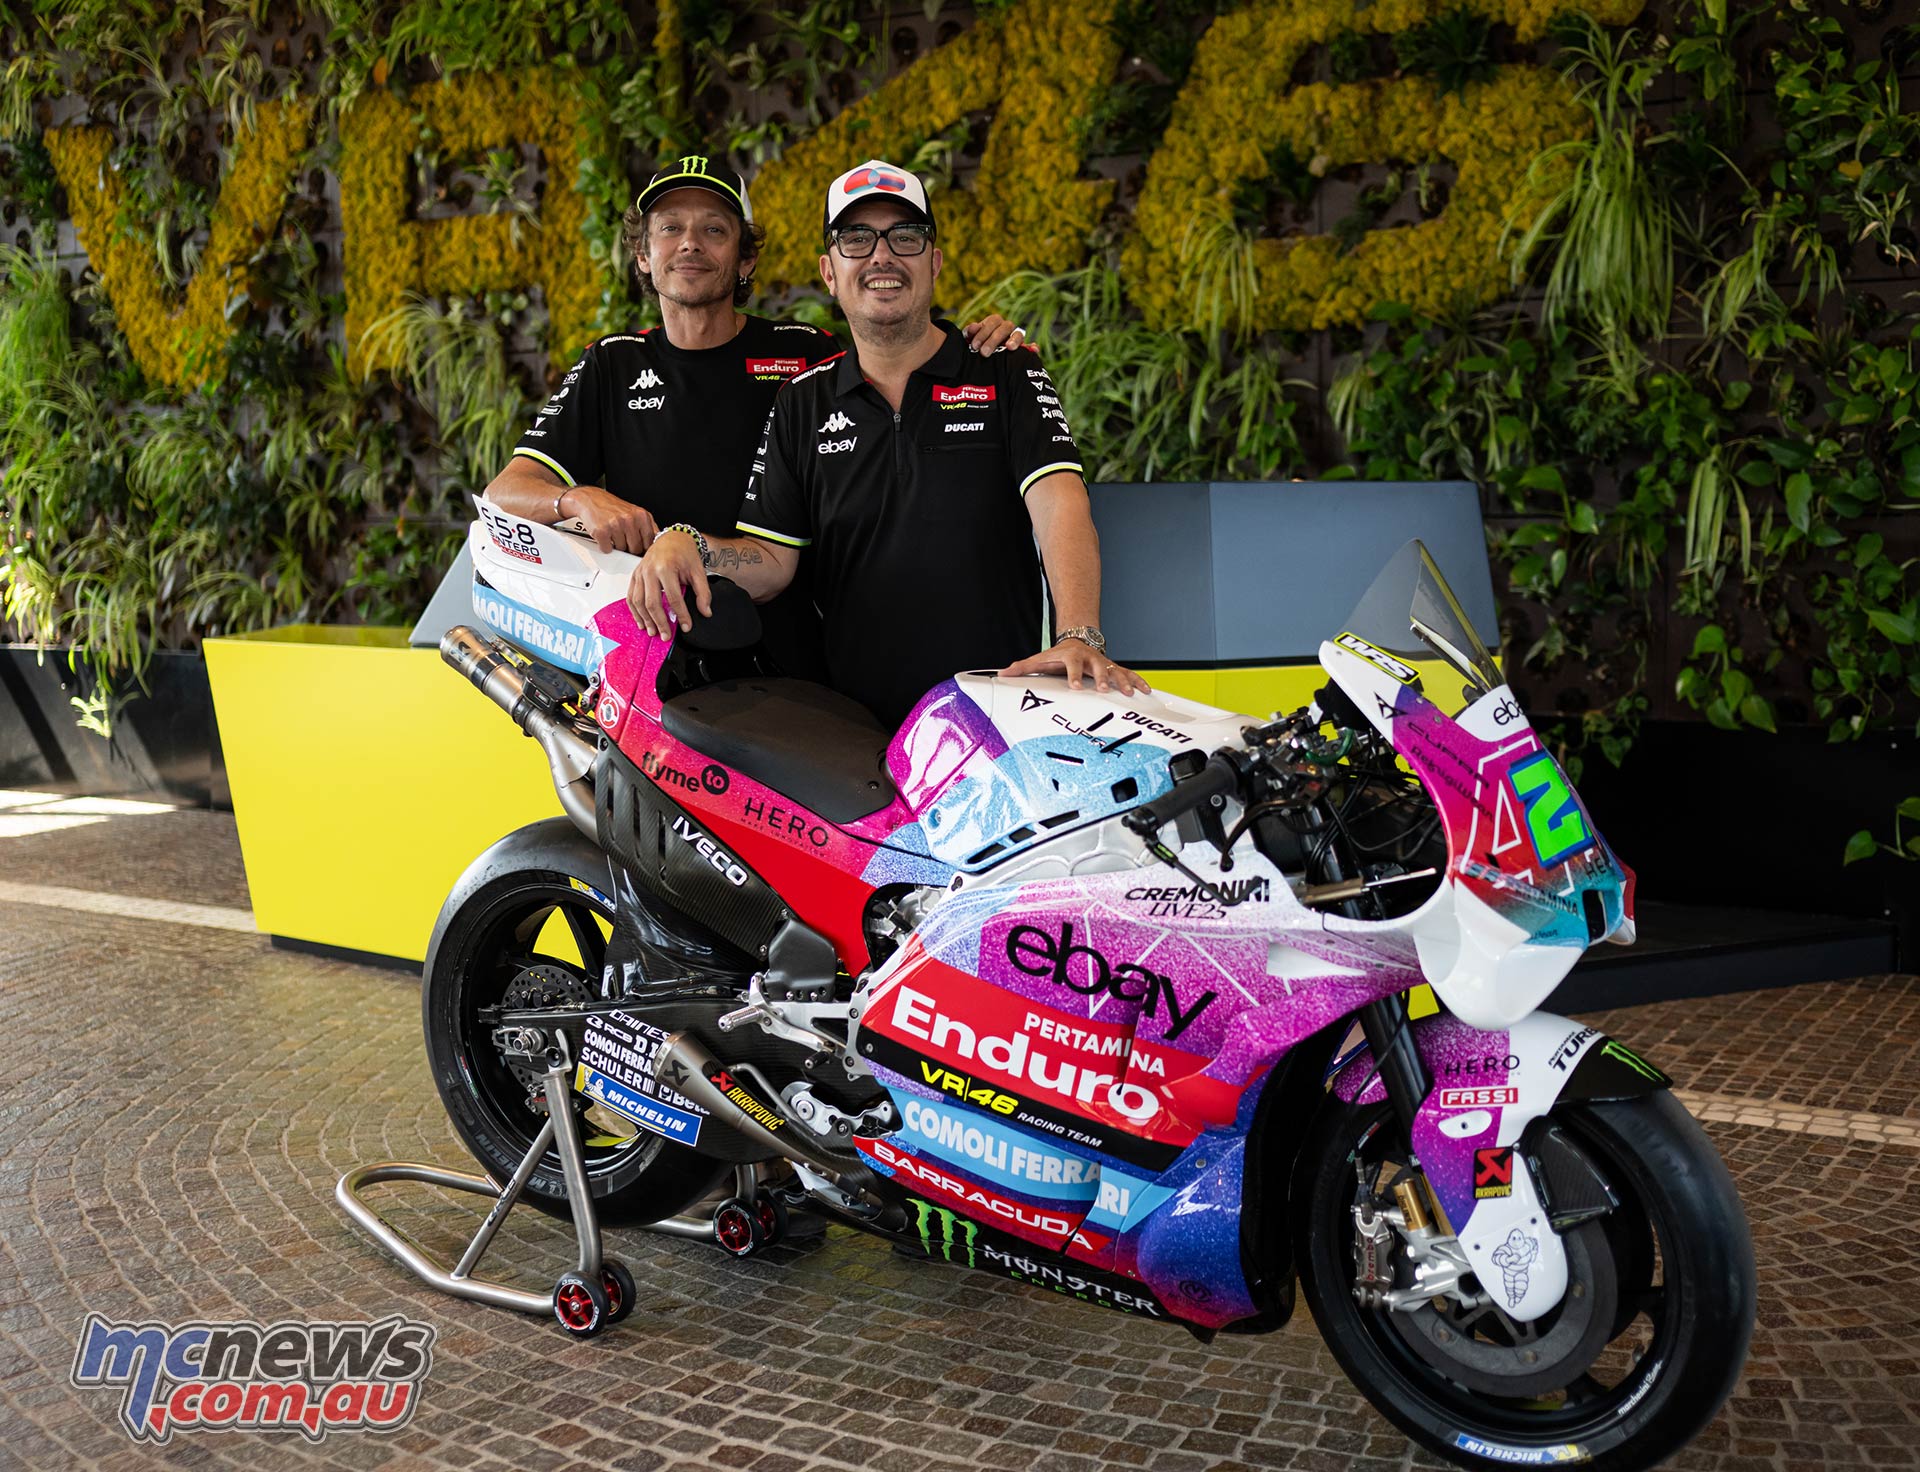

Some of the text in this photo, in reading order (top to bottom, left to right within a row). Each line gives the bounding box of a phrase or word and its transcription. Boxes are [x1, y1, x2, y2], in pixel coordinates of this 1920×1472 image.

[753, 364, 800, 373] Enduro
[627, 396, 665, 410] ebay
[940, 390, 989, 402] Enduro
[817, 436, 858, 454] ebay
[944, 422, 985, 433] DUCATI
[514, 610, 585, 665] FERRARI
[1339, 635, 1416, 679] WRS
[1051, 713, 1124, 759] CUPRA
[1121, 710, 1194, 745] DUCATI
[641, 751, 700, 793] flyme
[744, 797, 830, 847] HERO
[671, 815, 748, 887] IVECO
[1150, 902, 1227, 920] LIVE25
[1006, 921, 1218, 1041] ebay
[603, 1022, 634, 1044] RCB
[608, 1008, 672, 1042] DAINES
[1023, 1011, 1167, 1077] PERTAMINA
[583, 1028, 655, 1077] COMOLI FERRA
[891, 984, 1160, 1120] Enduro
[1444, 1054, 1520, 1076] HERO
[1552, 1026, 1598, 1072] TURB
[606, 1089, 688, 1133] MICHELIN
[1446, 1089, 1515, 1105] FASSI
[1016, 1111, 1066, 1137] RACING
[1065, 1128, 1103, 1148] TEAM
[904, 1100, 1131, 1215] COMOLI FERRARI
[874, 1142, 1094, 1251] BARRACUDA
[983, 1244, 1161, 1317] MONSTER
[1365, 1236, 1376, 1283] brembo
[1010, 1270, 1133, 1313] ENERGY
[1464, 1440, 1543, 1462] MICHELIN
